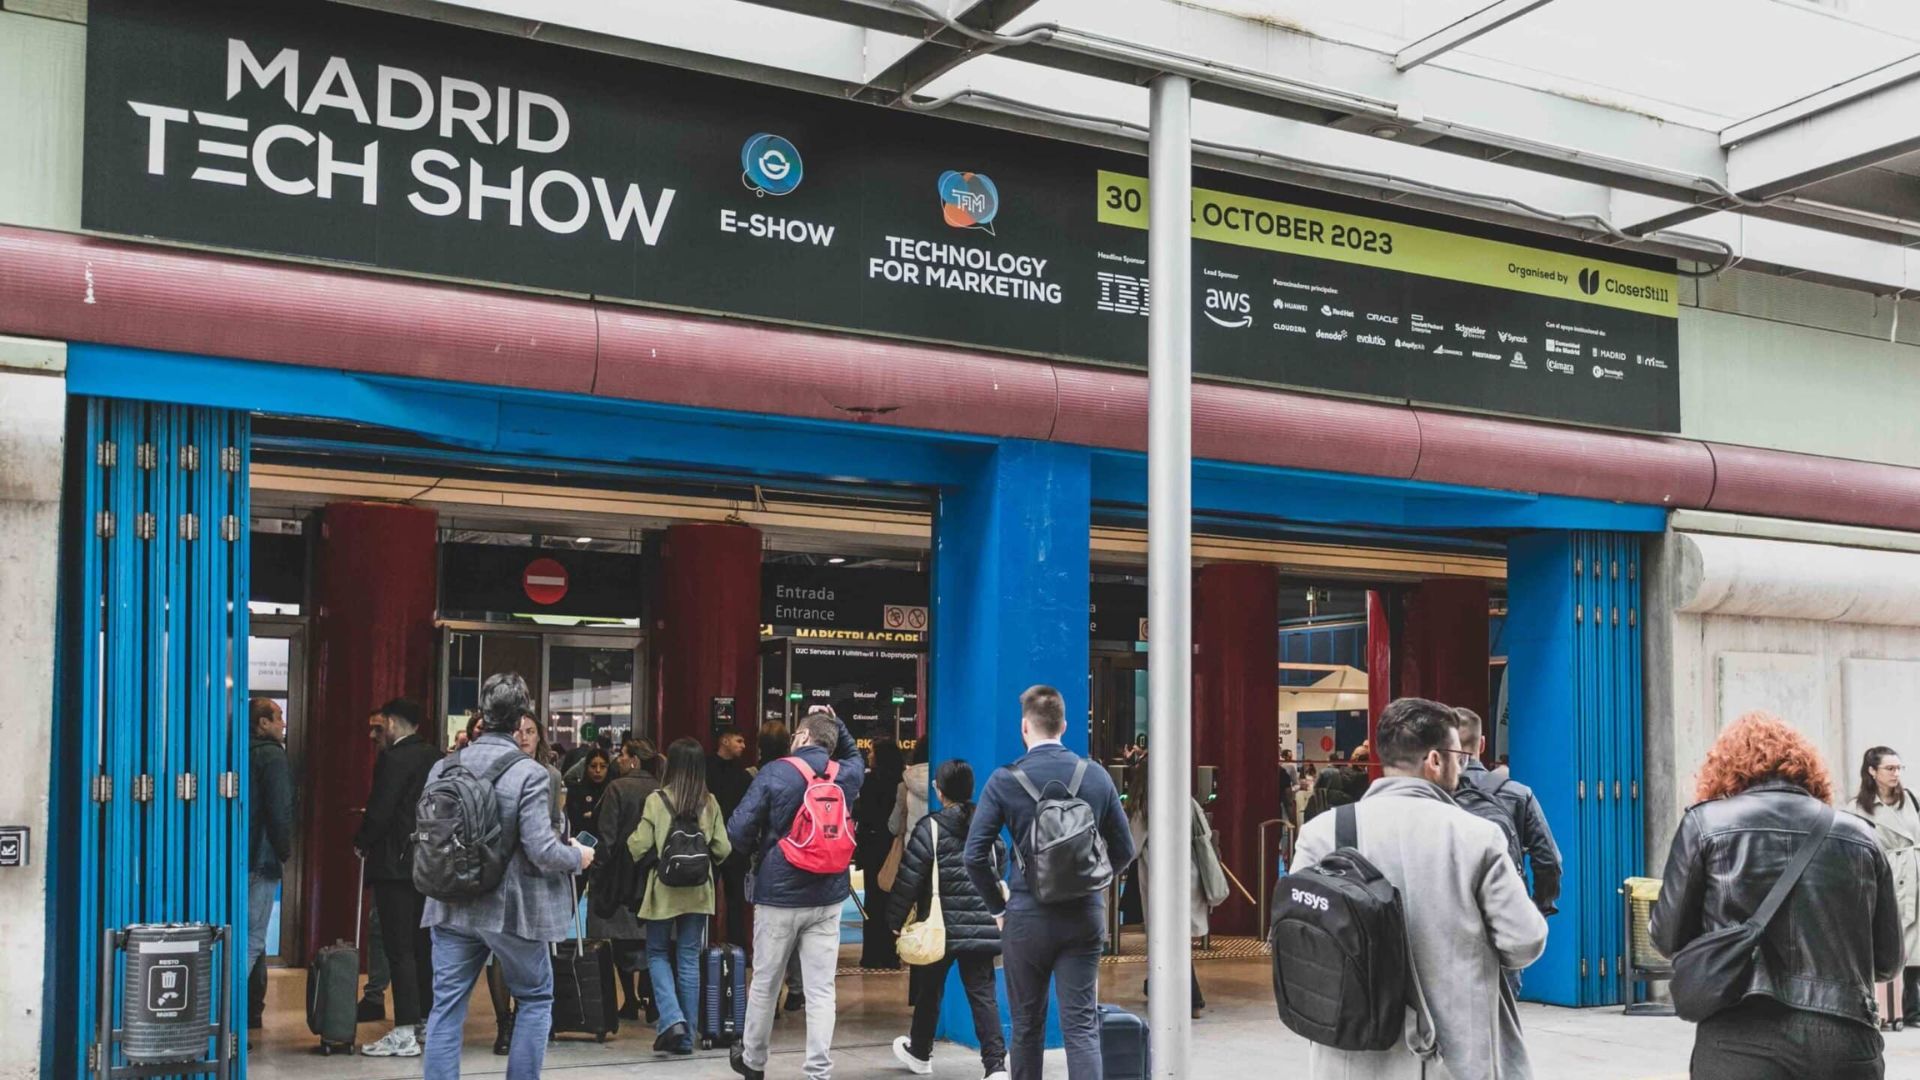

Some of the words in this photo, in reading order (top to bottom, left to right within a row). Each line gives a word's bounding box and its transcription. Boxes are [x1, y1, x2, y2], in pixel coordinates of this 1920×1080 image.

[228, 37, 570, 154] MADRID
[127, 100, 378, 205] TECH
[407, 149, 676, 246] SHOW
[720, 209, 835, 247] E-SHOW
[1106, 185, 1141, 213] 30
[1203, 202, 1325, 245] OCTOBER
[1330, 224, 1394, 254] 2023
[885, 235, 1047, 279] TECHNOLOGY
[869, 258, 920, 282] FOR
[925, 266, 1062, 304] MARKETING
[1508, 262, 1555, 281] Organised
[1557, 273, 1568, 284] by
[1097, 271, 1149, 317] IB
[1205, 287, 1250, 313] aws
[1605, 278, 1669, 303] CloserStill
[1284, 301, 1308, 312] HUAWEI
[1366, 312, 1399, 324] ORACLE
[1315, 329, 1342, 341] denodo
[1455, 323, 1486, 335] Schneider
[1600, 349, 1627, 361] MADRID
[776, 585, 835, 600] Entrada
[775, 605, 835, 621] Entrance
[1291, 887, 1329, 911] arsys
